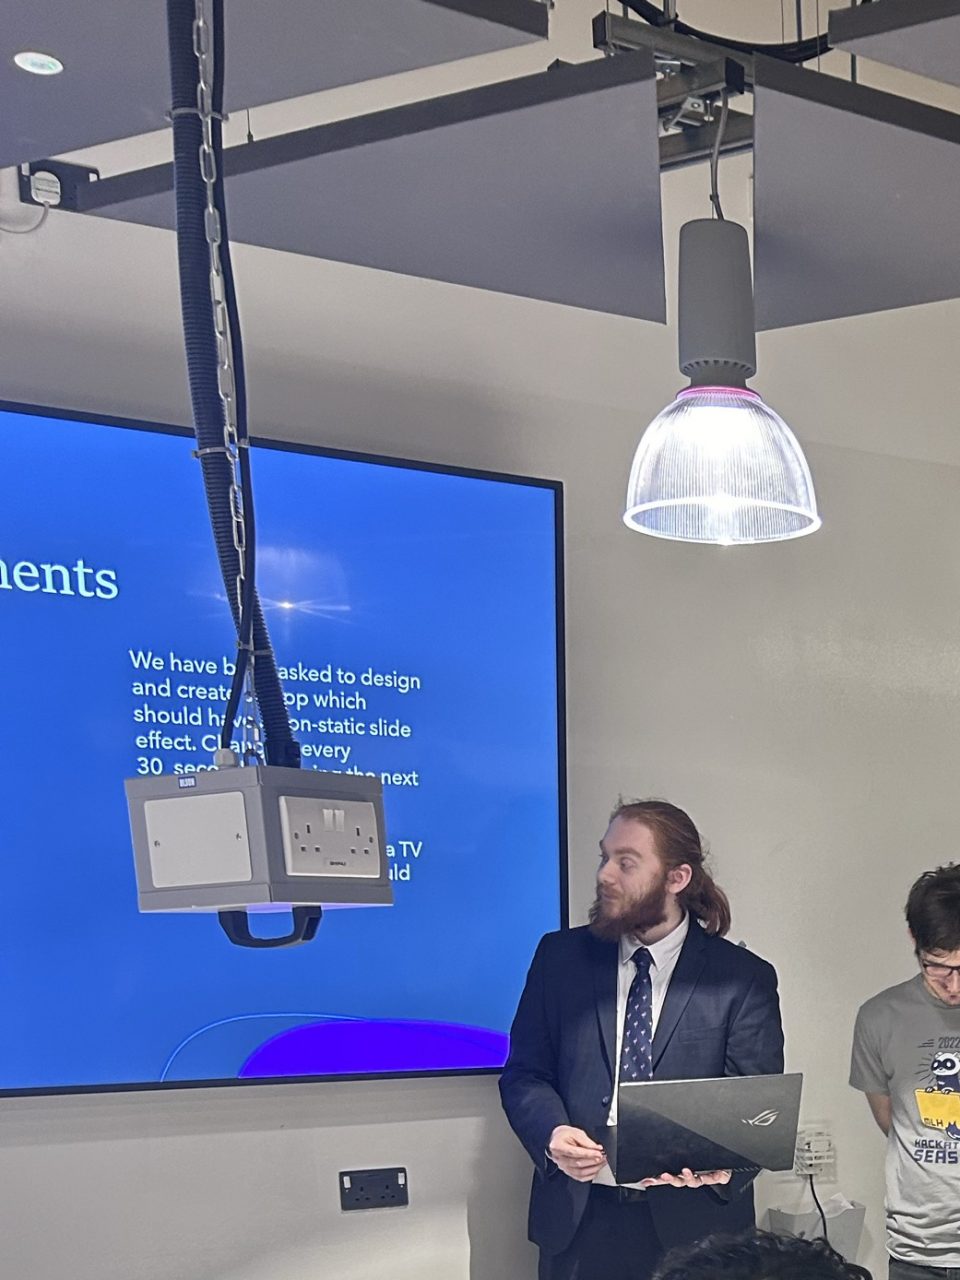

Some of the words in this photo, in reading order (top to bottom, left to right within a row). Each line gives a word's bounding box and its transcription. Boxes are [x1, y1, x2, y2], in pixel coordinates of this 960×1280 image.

[128, 649, 165, 671] We
[169, 651, 217, 675] have
[278, 661, 332, 684] asked
[336, 668, 356, 685] to
[360, 667, 421, 694] design
[132, 677, 171, 698] and
[283, 691, 309, 711] pp
[313, 689, 367, 711] which
[133, 703, 202, 726] should
[288, 717, 366, 736] on-static
[369, 717, 412, 738] slide
[135, 730, 197, 752] effect.
[301, 744, 351, 764] every
[137, 756, 163, 776] 30
[380, 770, 419, 787] next
[398, 841, 423, 858] TV
[938, 1037, 960, 1049] 2022
